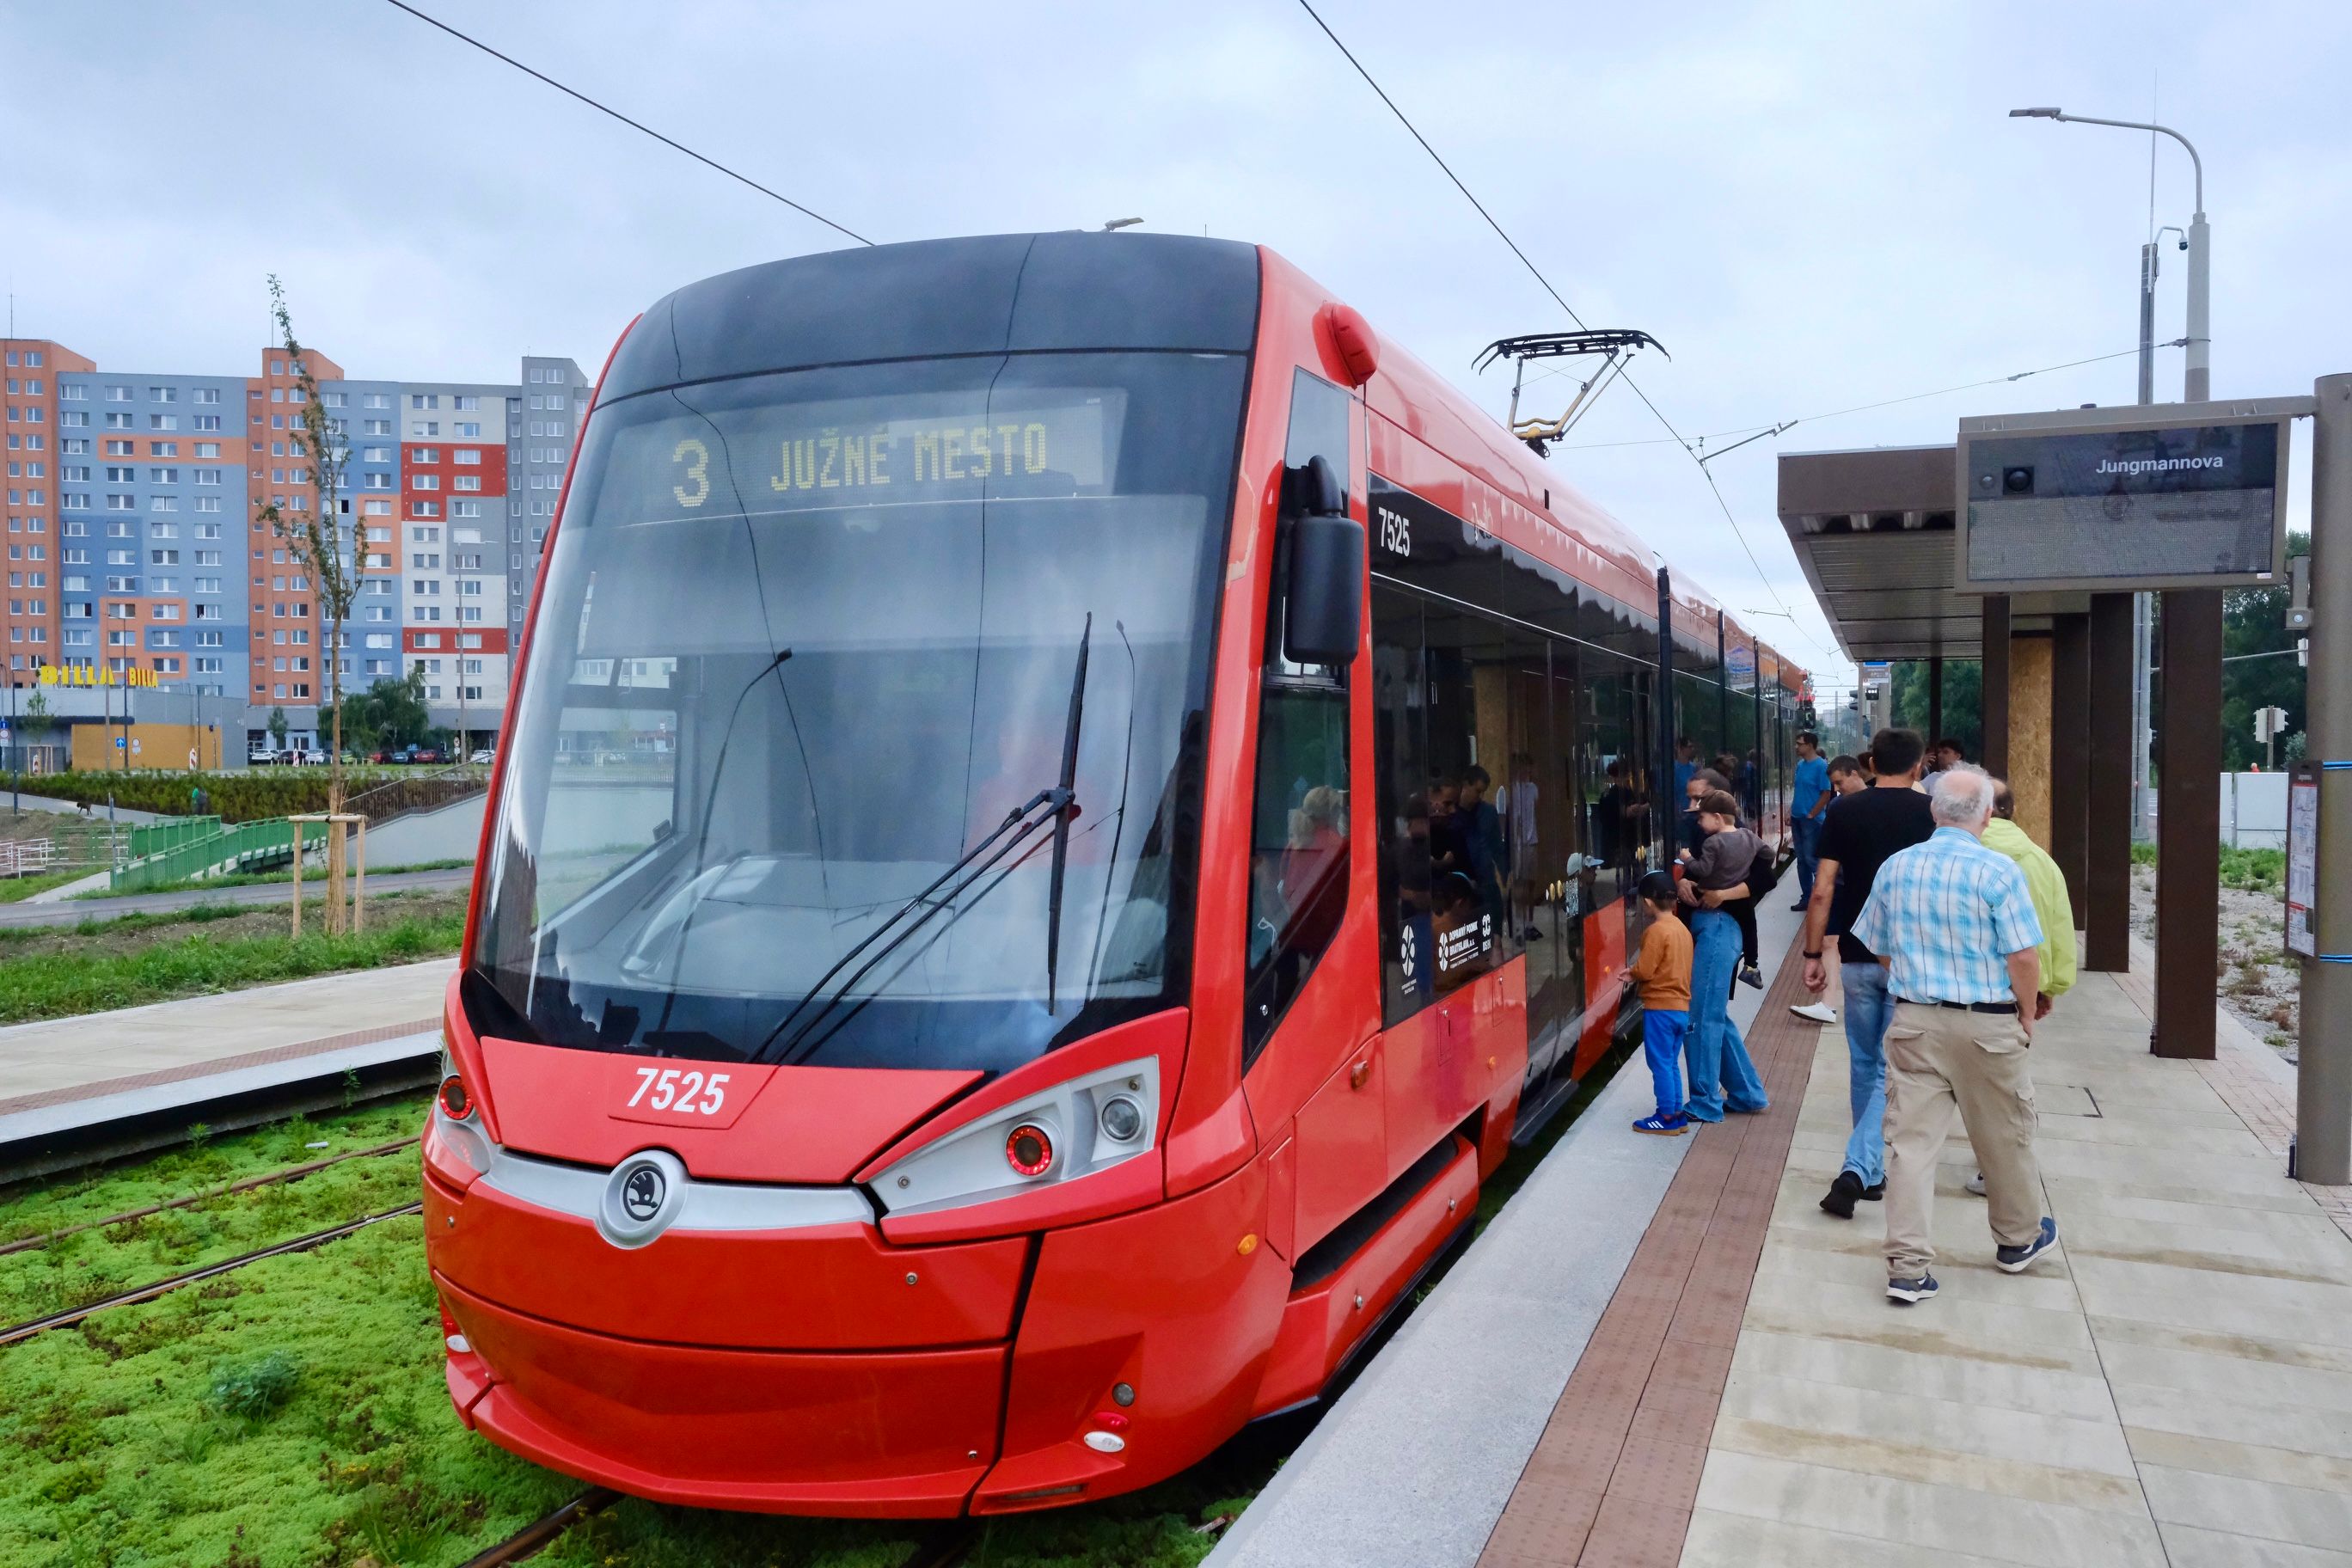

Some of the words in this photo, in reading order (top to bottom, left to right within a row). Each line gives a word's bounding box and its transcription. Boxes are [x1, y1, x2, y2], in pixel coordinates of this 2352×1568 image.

[673, 439, 709, 507] 3
[771, 425, 890, 491] JUŽNÉ
[915, 423, 1046, 481] MESTO
[2096, 456, 2224, 475] Jungmannova
[1378, 506, 1411, 557] 7525
[40, 665, 116, 686] BILLA
[127, 666, 159, 688] BILLA
[627, 1067, 731, 1115] 7525
